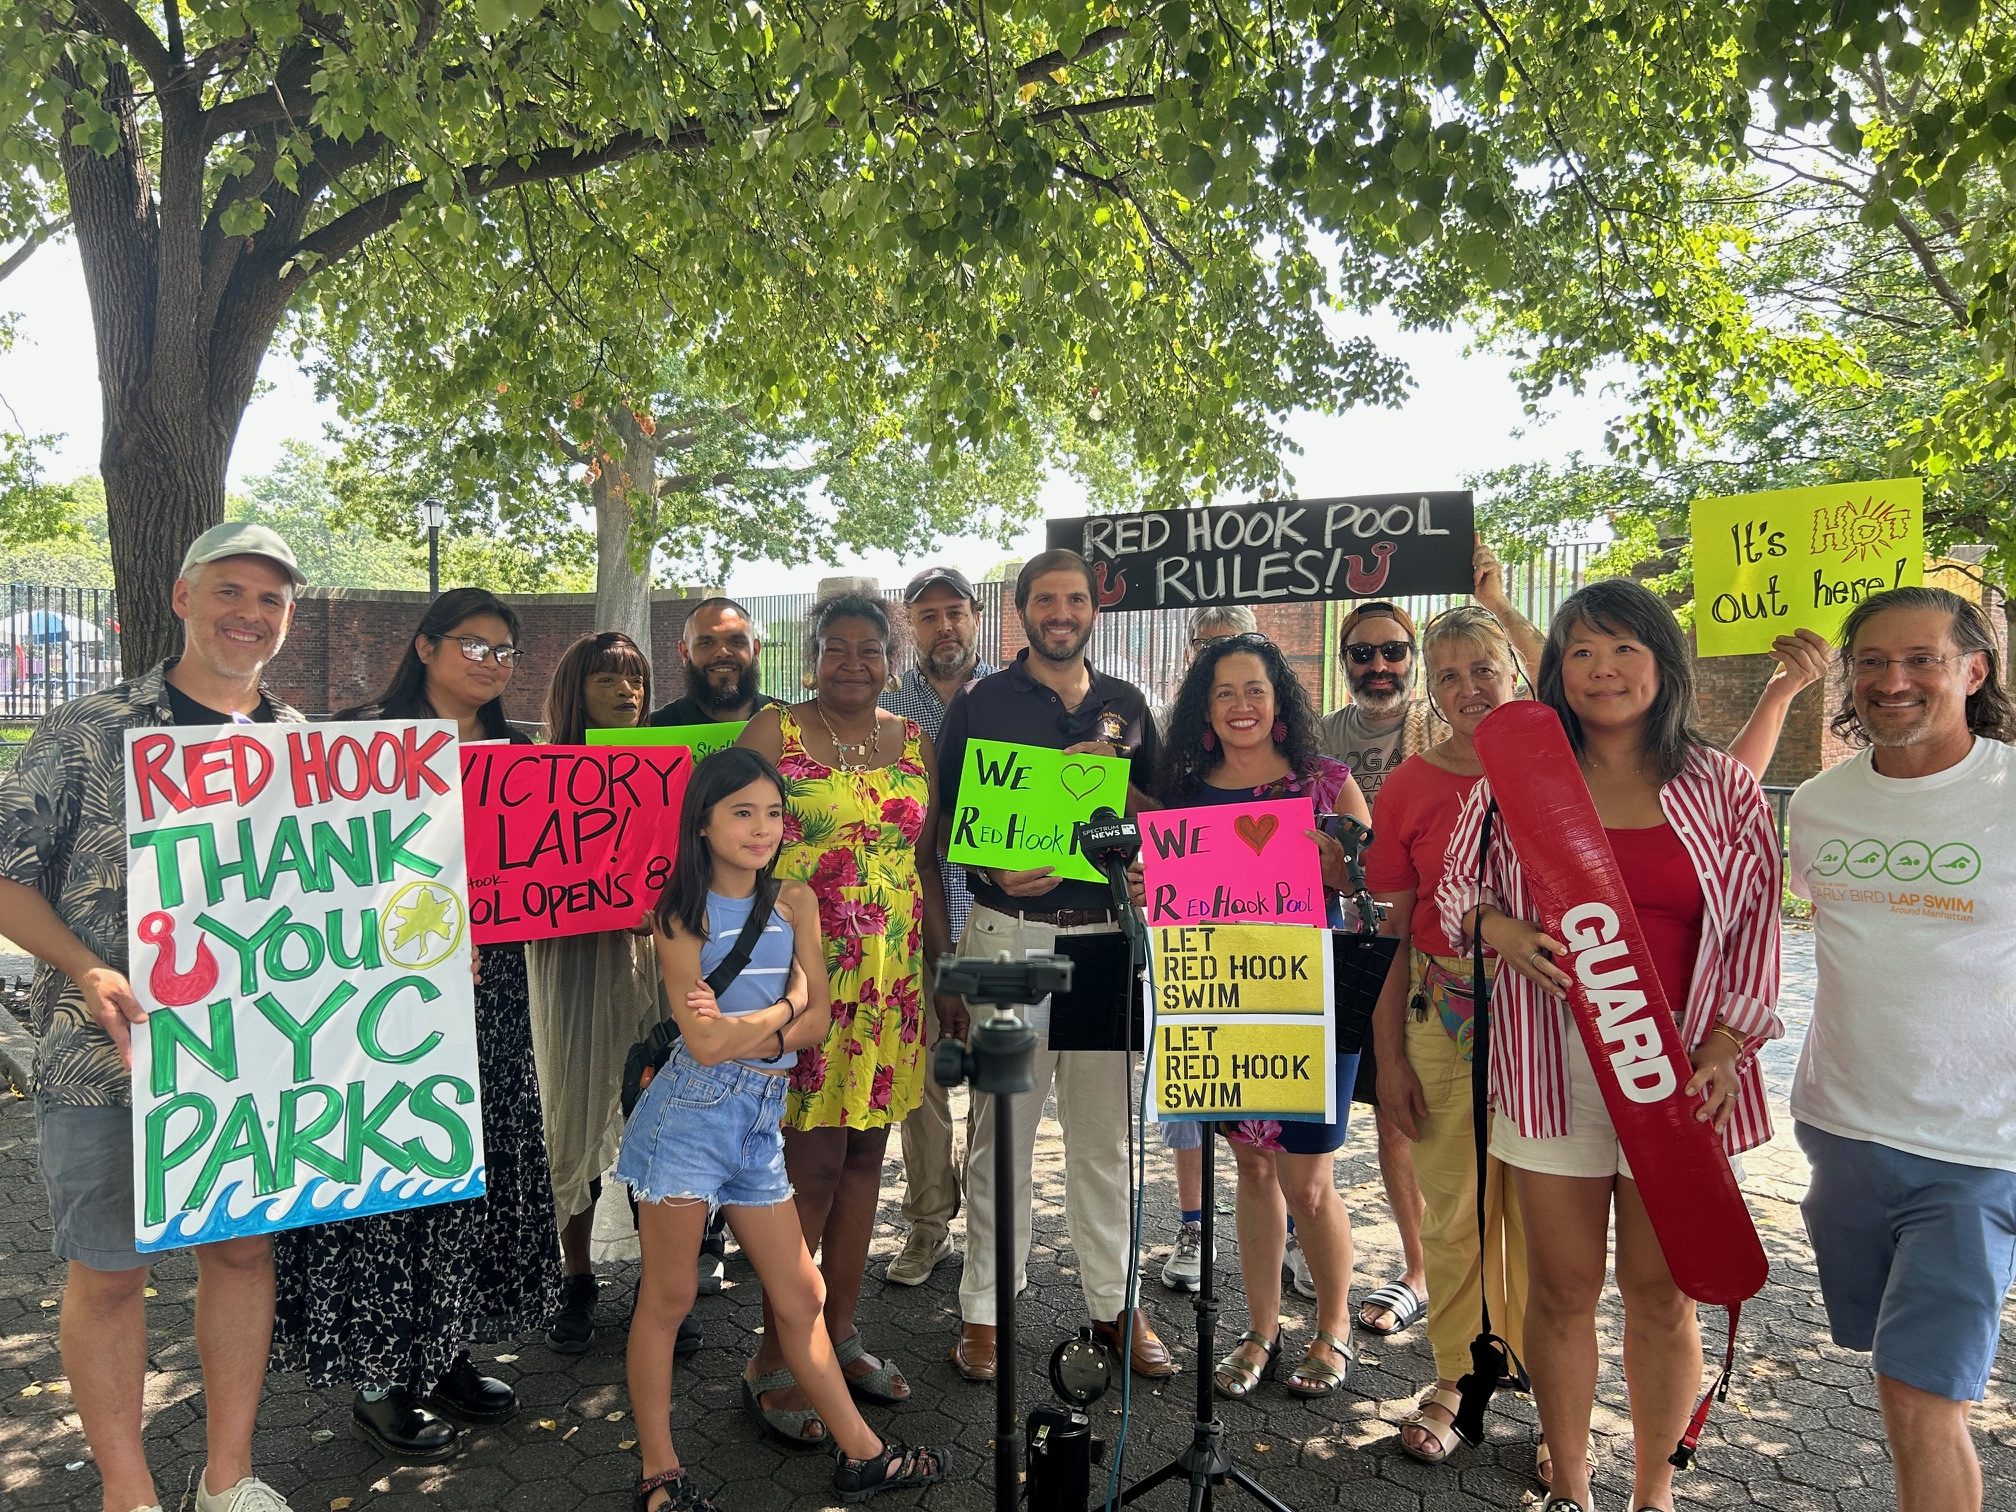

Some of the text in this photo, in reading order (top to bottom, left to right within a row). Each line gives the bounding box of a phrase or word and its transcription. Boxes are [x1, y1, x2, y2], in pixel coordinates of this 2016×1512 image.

[1083, 496, 1450, 561] RED HOOK POOL
[1731, 504, 1911, 566] It's HOT
[1155, 546, 1342, 606] RULES!
[1711, 575, 1789, 624] out
[132, 726, 454, 821] RED HOOK
[976, 748, 1032, 790] WE
[1344, 748, 1403, 774] OGA
[498, 806, 631, 870] LAP!
[1082, 825, 1119, 836] SPECTRUM
[1091, 830, 1120, 840] NEWS
[1149, 819, 1211, 860] WE
[130, 811, 443, 909] THANK
[523, 873, 634, 928] OPENS
[1850, 889, 1885, 903] BIRD
[1888, 892, 1920, 906] LAP
[1923, 894, 1974, 913] SWIM
[1890, 905, 1973, 921] Around Manhattan
[193, 905, 383, 997] YOU
[1162, 927, 1215, 953] LET
[1164, 954, 1309, 982] RED HOOK
[1163, 982, 1240, 1009] SWIM
[1560, 902, 1677, 1104] GUARD
[1164, 1026, 1218, 1051] LET
[1166, 1054, 1310, 1080] RED HOOK
[1164, 1082, 1241, 1109] SWIM
[144, 1074, 475, 1227] PARKS
